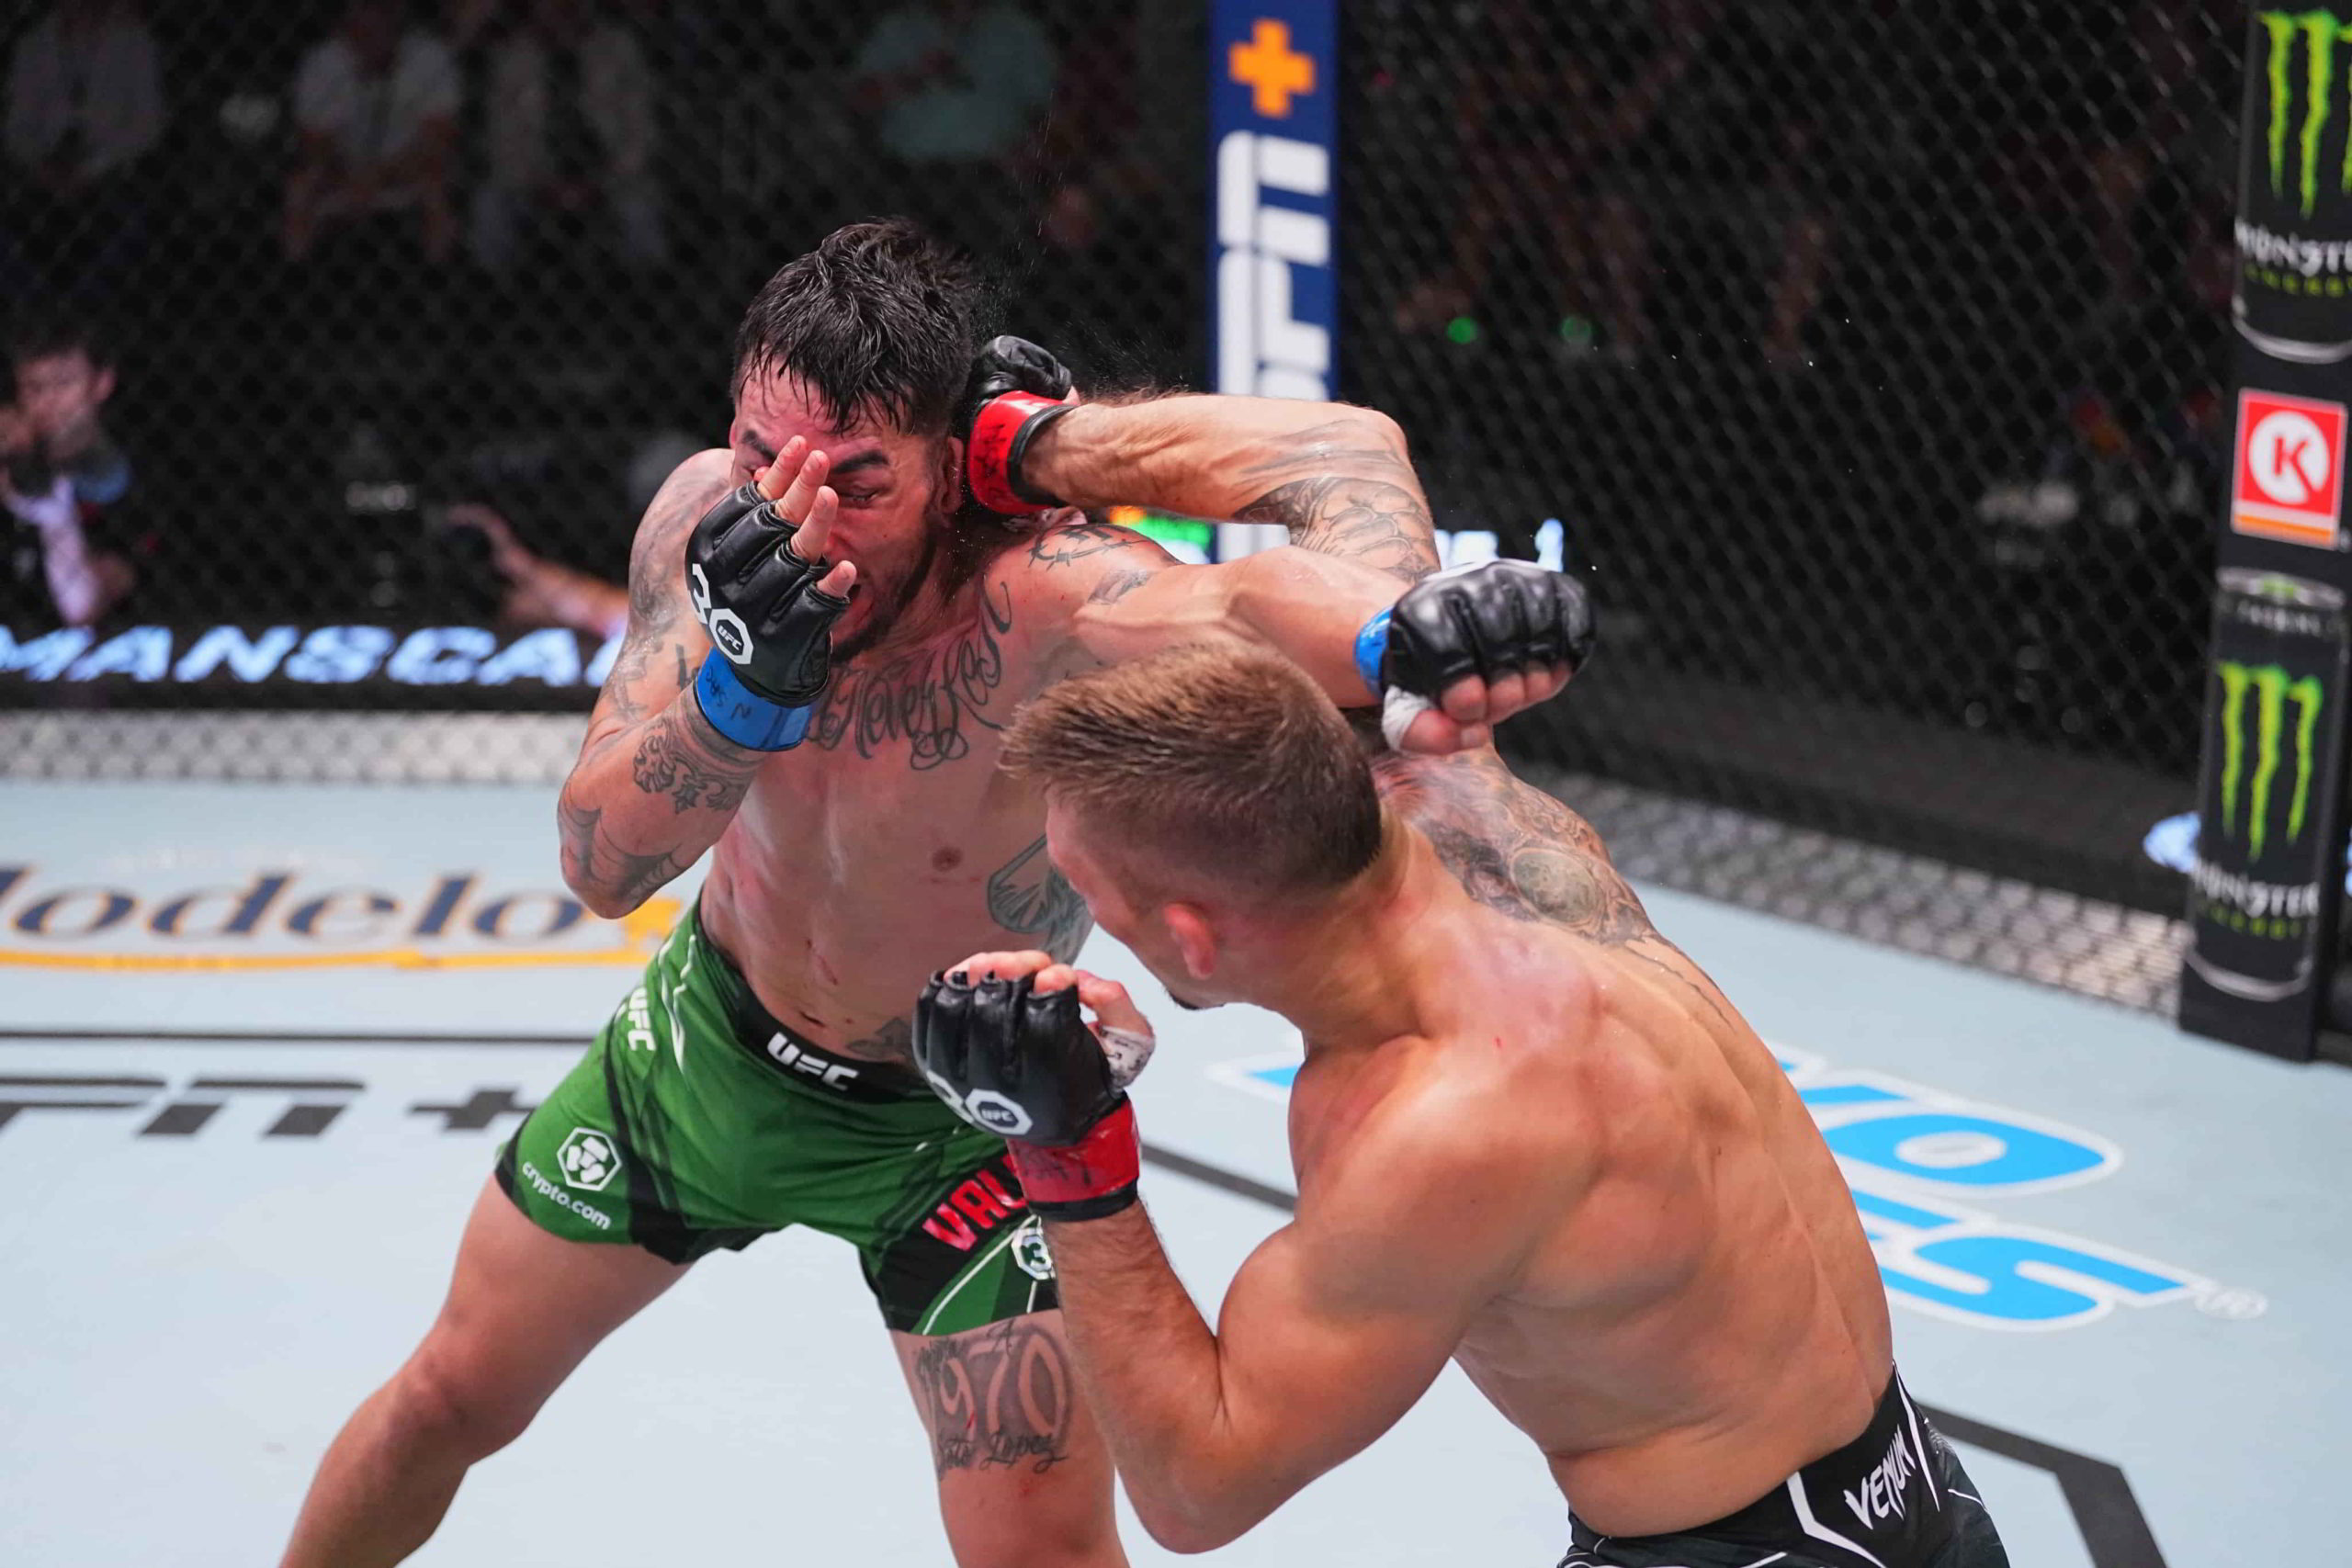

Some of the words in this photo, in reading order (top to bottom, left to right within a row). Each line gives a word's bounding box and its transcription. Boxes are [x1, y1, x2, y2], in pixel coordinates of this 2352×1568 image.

[0, 625, 627, 685] MANSCA
[717, 624, 742, 651] UFC
[0, 865, 588, 944] odelo
[628, 987, 657, 1052] UFC
[766, 1031, 860, 1092] UFC
[521, 1161, 612, 1231] crypto.com
[1843, 1423, 1917, 1530] VENUM
